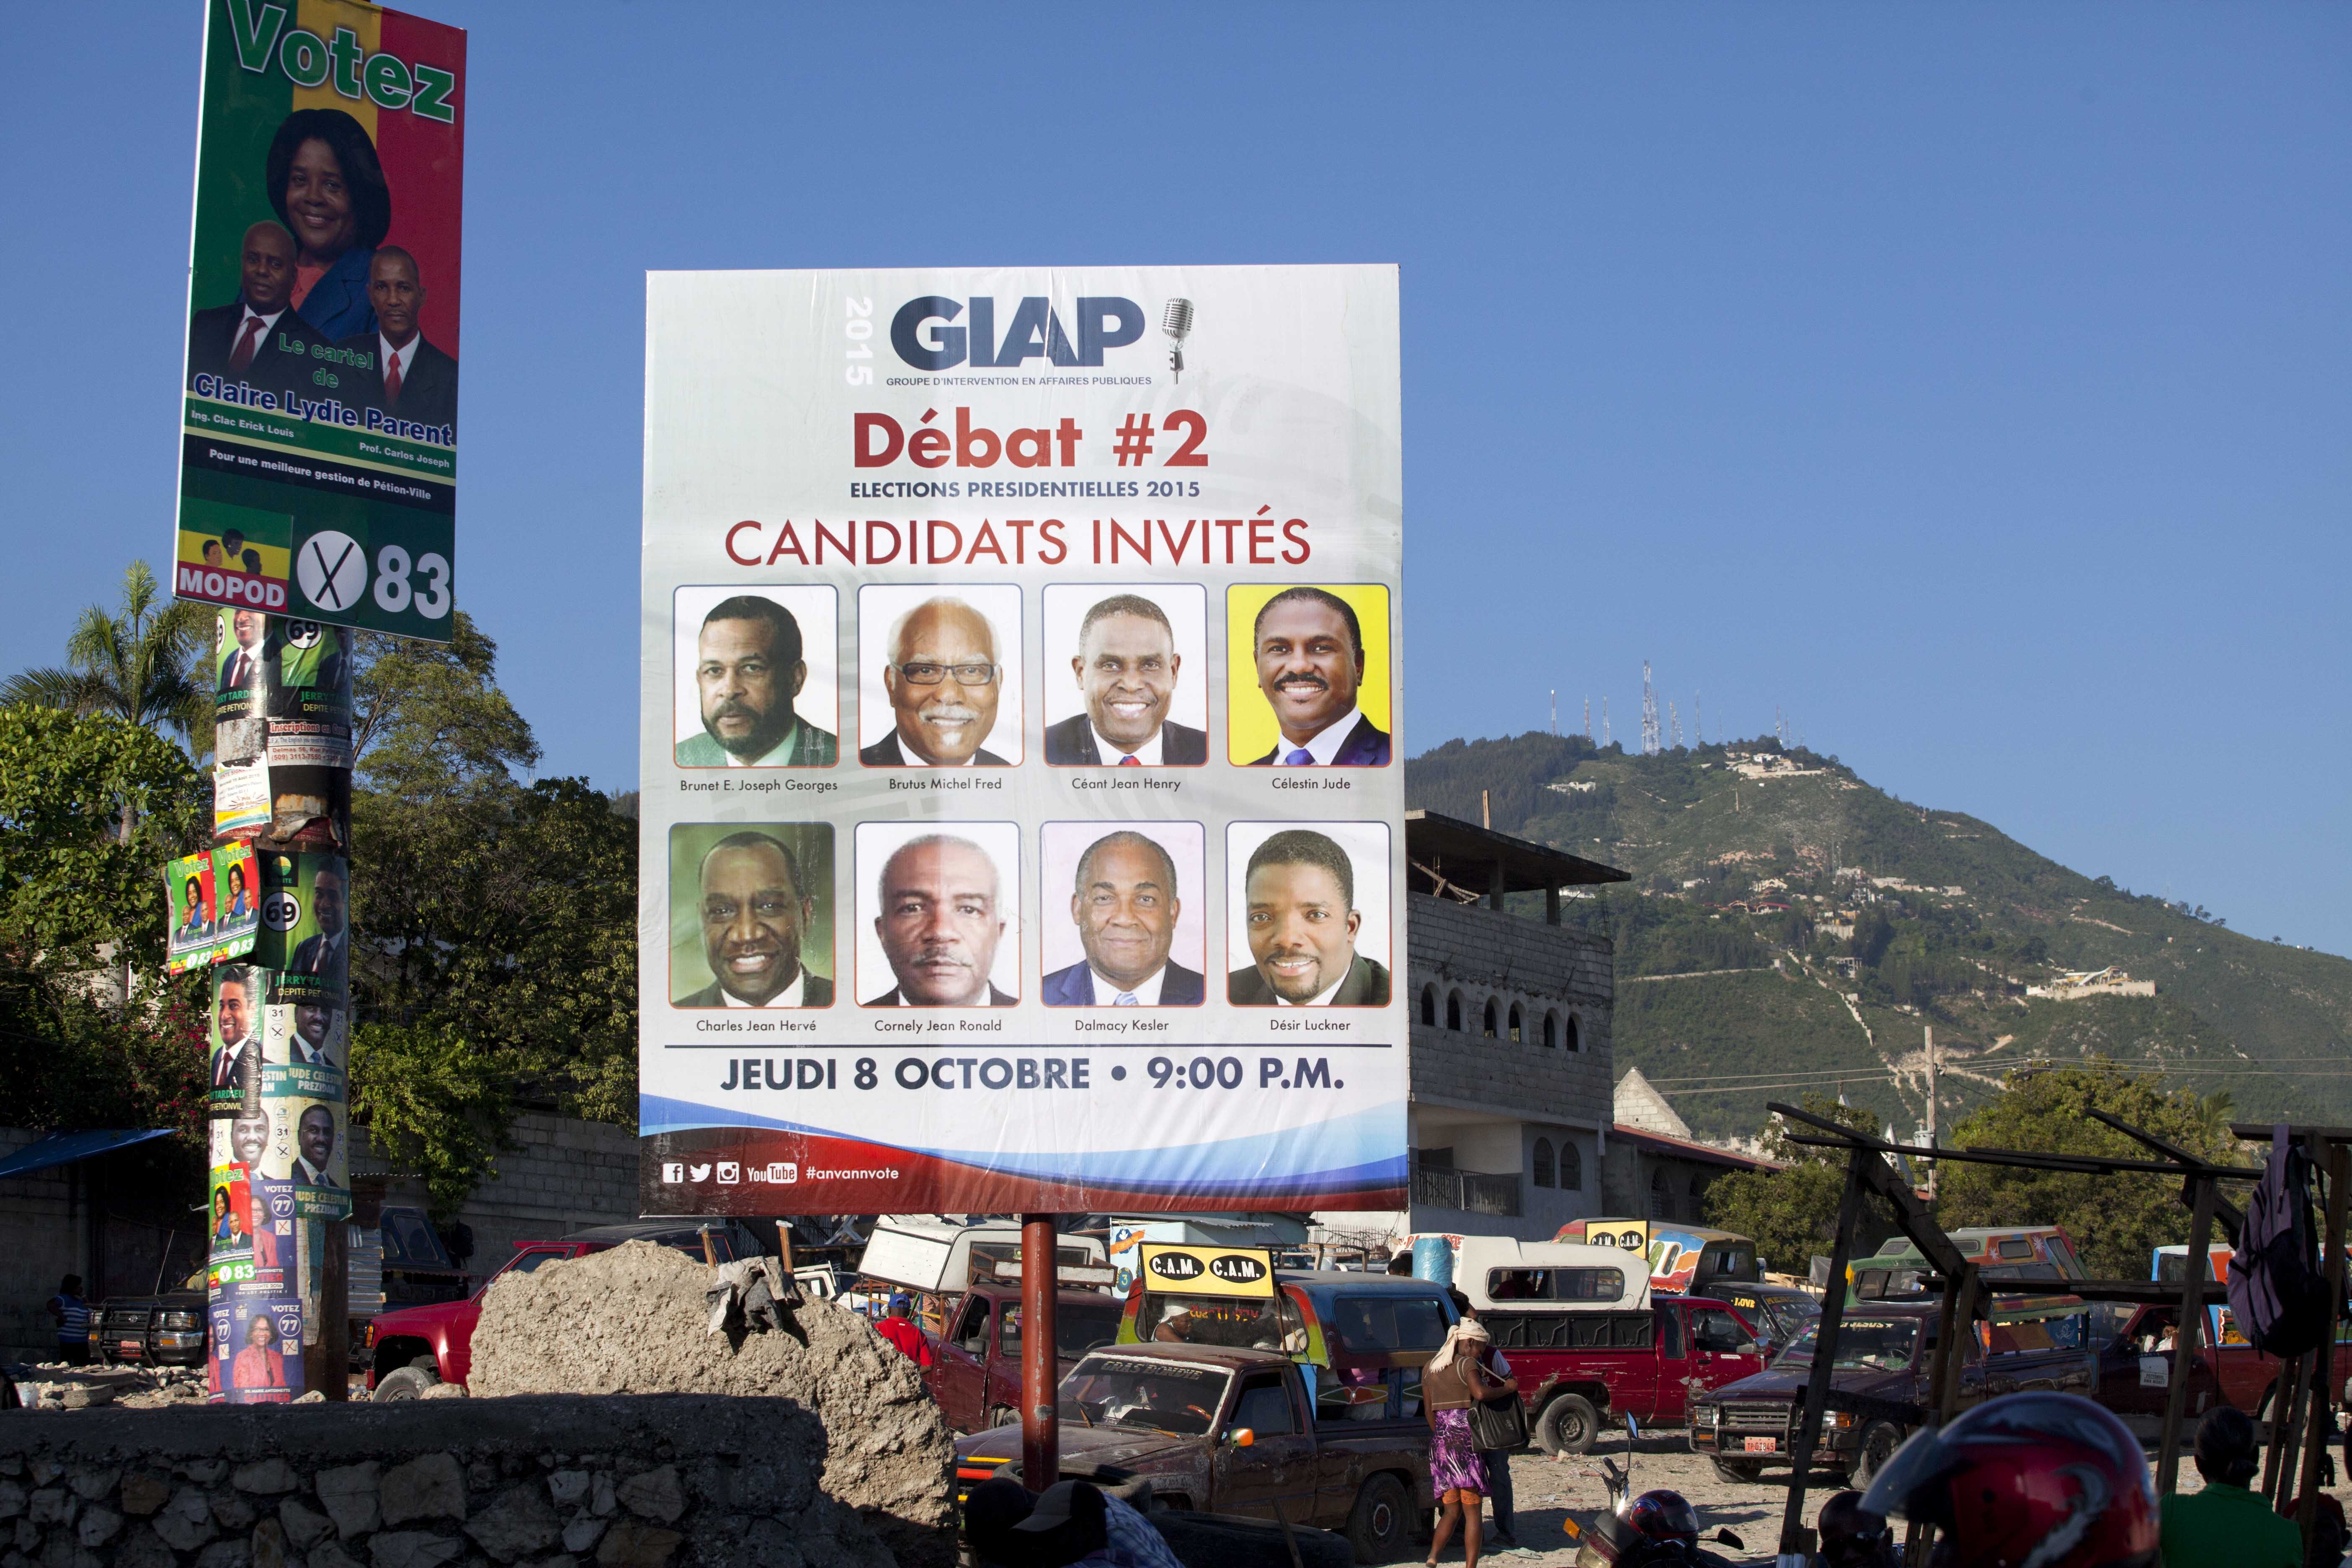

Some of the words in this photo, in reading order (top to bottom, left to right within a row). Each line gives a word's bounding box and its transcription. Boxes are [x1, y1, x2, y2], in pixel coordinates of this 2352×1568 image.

[228, 0, 454, 124] Votez
[890, 295, 1145, 371] GIAP
[846, 296, 873, 386] 2015
[279, 333, 304, 355] Le
[311, 344, 374, 370] cartel
[312, 368, 338, 388] de
[886, 377, 930, 386] GROUPE
[934, 377, 1019, 386] D'INTERVENTION
[1021, 377, 1037, 386] EN
[1039, 376, 1089, 386] AFFAIRES
[1092, 376, 1152, 386] PUBLIQUES
[194, 373, 277, 411] Claire
[285, 391, 357, 427] Lydie
[366, 407, 452, 447] Parent
[191, 411, 211, 424] Ing.
[213, 415, 236, 427] Clac
[239, 419, 265, 432] Erick
[268, 424, 294, 438] Louis
[854, 407, 1083, 469] Débat
[1113, 409, 1209, 467] #2
[359, 442, 382, 454] Prof.
[384, 447, 414, 461] Carlos
[417, 454, 450, 469] Joseph
[209, 449, 235, 463] Pour
[238, 456, 258, 466] une
[261, 458, 312, 476] meilleure
[315, 469, 355, 485] gestion
[357, 476, 371, 487] de
[374, 479, 431, 500] Pétion-Ville
[851, 482, 960, 498] ELECTIONS
[968, 481, 1139, 498] PRESIDENTIELLES
[1147, 480, 1200, 498] 2015
[725, 518, 1068, 567] CANDIDATS
[1093, 504, 1311, 566] INVITÉS
[179, 568, 285, 607] MOPOD
[374, 544, 451, 619] 83
[290, 620, 318, 640] 69
[300, 691, 328, 702] JERRY
[303, 704, 328, 712] DEPITE
[271, 721, 320, 734] Inscriptions
[322, 725, 331, 733] en
[681, 780, 719, 791] Brunet
[723, 780, 735, 791] E.
[739, 779, 781, 794] Joseph
[785, 779, 838, 794] Georges
[890, 778, 926, 790] Brutus
[931, 778, 971, 789] Michel
[975, 778, 1002, 789] Fred
[1072, 778, 1108, 789] Céant
[1111, 778, 1140, 789] Jean
[1144, 778, 1181, 792] Henry
[1272, 778, 1319, 789] Célestin
[1322, 778, 1351, 789] Jude
[217, 845, 251, 866] Votez
[174, 858, 209, 878] Votez
[266, 901, 296, 922] 69
[240, 938, 254, 952] 83
[198, 951, 212, 965] 83
[272, 1009, 284, 1017] 31
[696, 1020, 743, 1032] Charles
[747, 1020, 775, 1032] Jean
[780, 1020, 816, 1032] Hervé
[874, 1020, 922, 1034] Cornely
[926, 1020, 955, 1032] Jean
[960, 1020, 1002, 1032] Ronald
[1075, 1019, 1128, 1034] Dalmacy
[1132, 1019, 1169, 1031] Kesler
[1270, 1019, 1300, 1031] Désir
[1305, 1019, 1351, 1031] Luckner
[262, 1070, 286, 1081] ESTIN
[720, 1058, 836, 1091] JEUDI
[854, 1057, 878, 1090] 8
[895, 1057, 1089, 1090] OCTOBRE
[1147, 1056, 1243, 1089] 9:00
[1260, 1057, 1344, 1089] P.M.
[298, 1080, 335, 1095] PREZIDAN
[807, 1166, 899, 1180] #anvannvote
[274, 1200, 291, 1212] 77
[1620, 1235, 1640, 1247] C.A.M.
[234, 1264, 255, 1279] 83
[1153, 1257, 1198, 1275] C.A.M.
[1213, 1259, 1260, 1278] C.A.M.
[1121, 1274, 1128, 1286] 3
[213, 1309, 230, 1318] VOTEZ
[218, 1324, 229, 1336] 77
[282, 1320, 298, 1331] 77
[1101, 1361, 1144, 1373] GRAS
